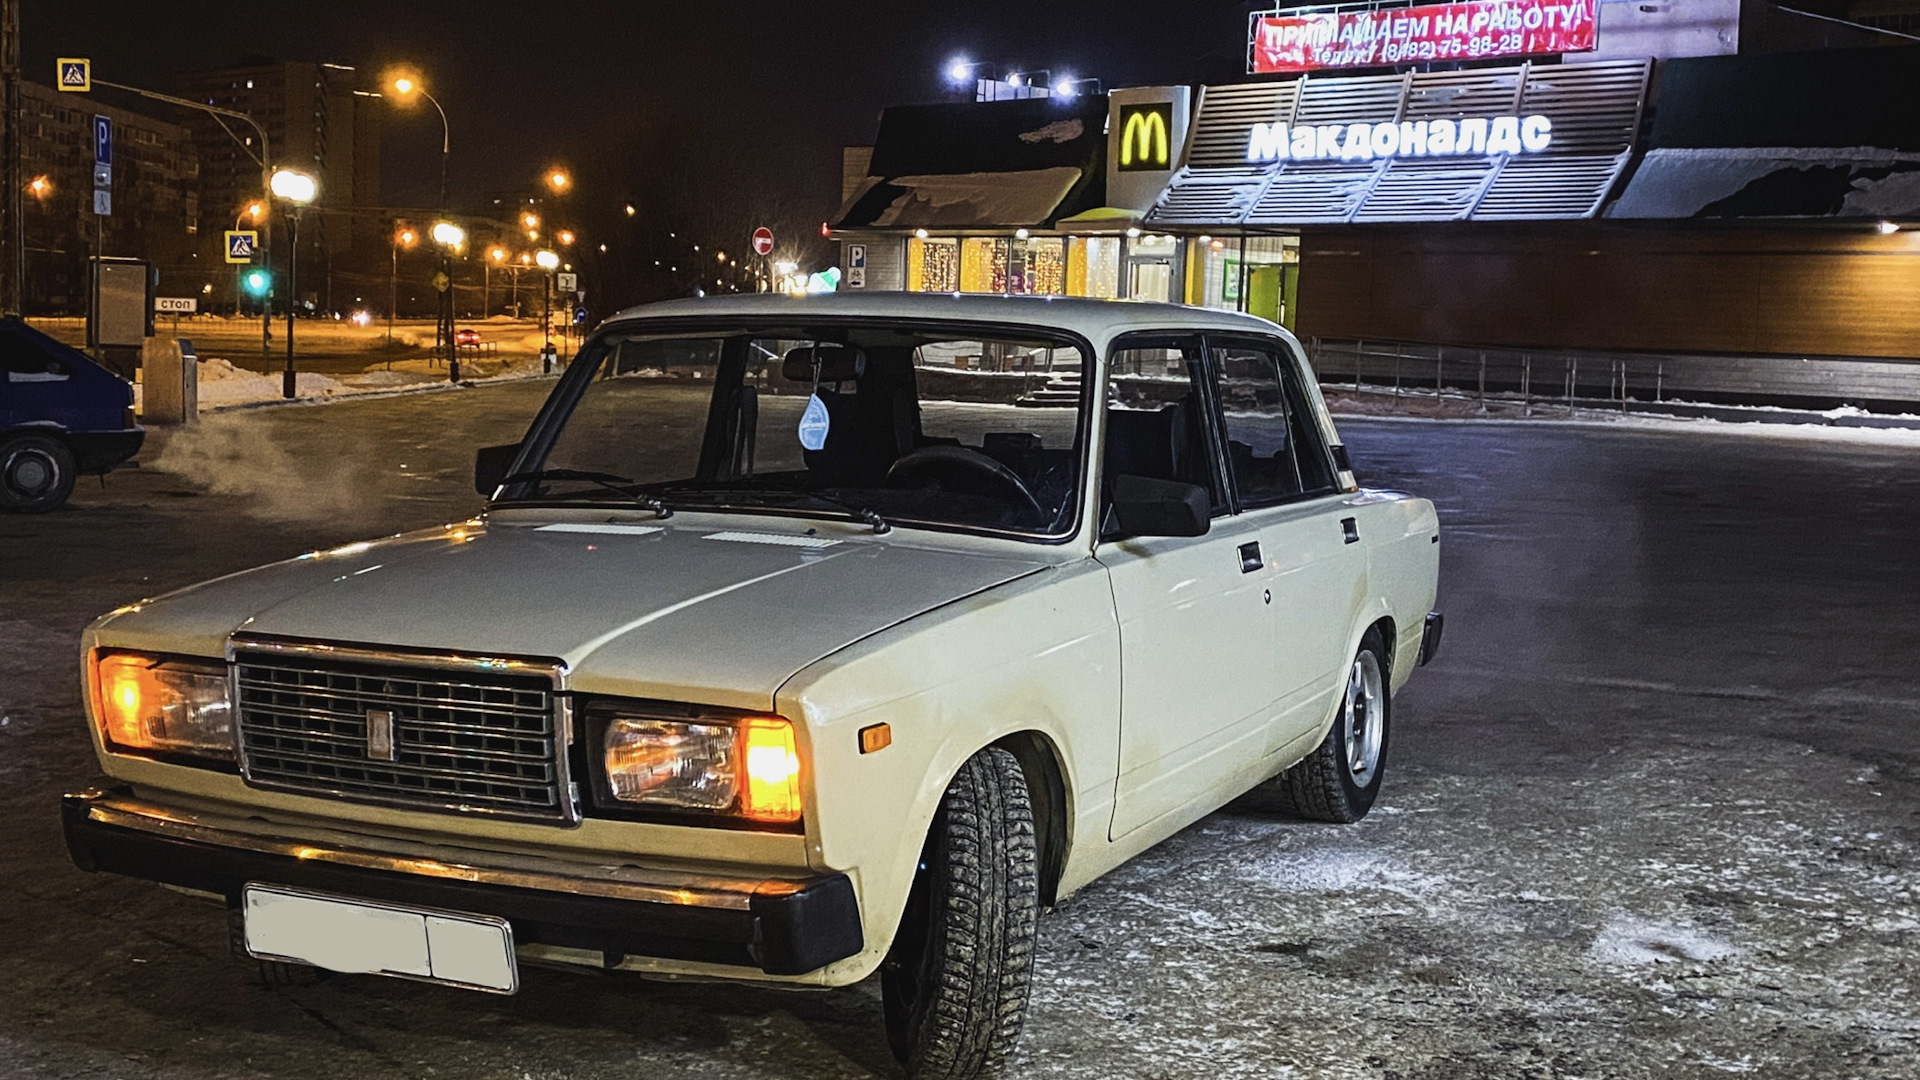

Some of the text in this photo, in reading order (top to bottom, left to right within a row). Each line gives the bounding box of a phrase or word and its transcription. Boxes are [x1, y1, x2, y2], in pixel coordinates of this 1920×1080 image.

[1434, 14, 1469, 37] НА
[1439, 34, 1523, 55] 75-98-28
[98, 121, 108, 157] P
[1247, 115, 1552, 160] Макдоналдс
[851, 246, 863, 267] P
[161, 300, 190, 309] СТОП
